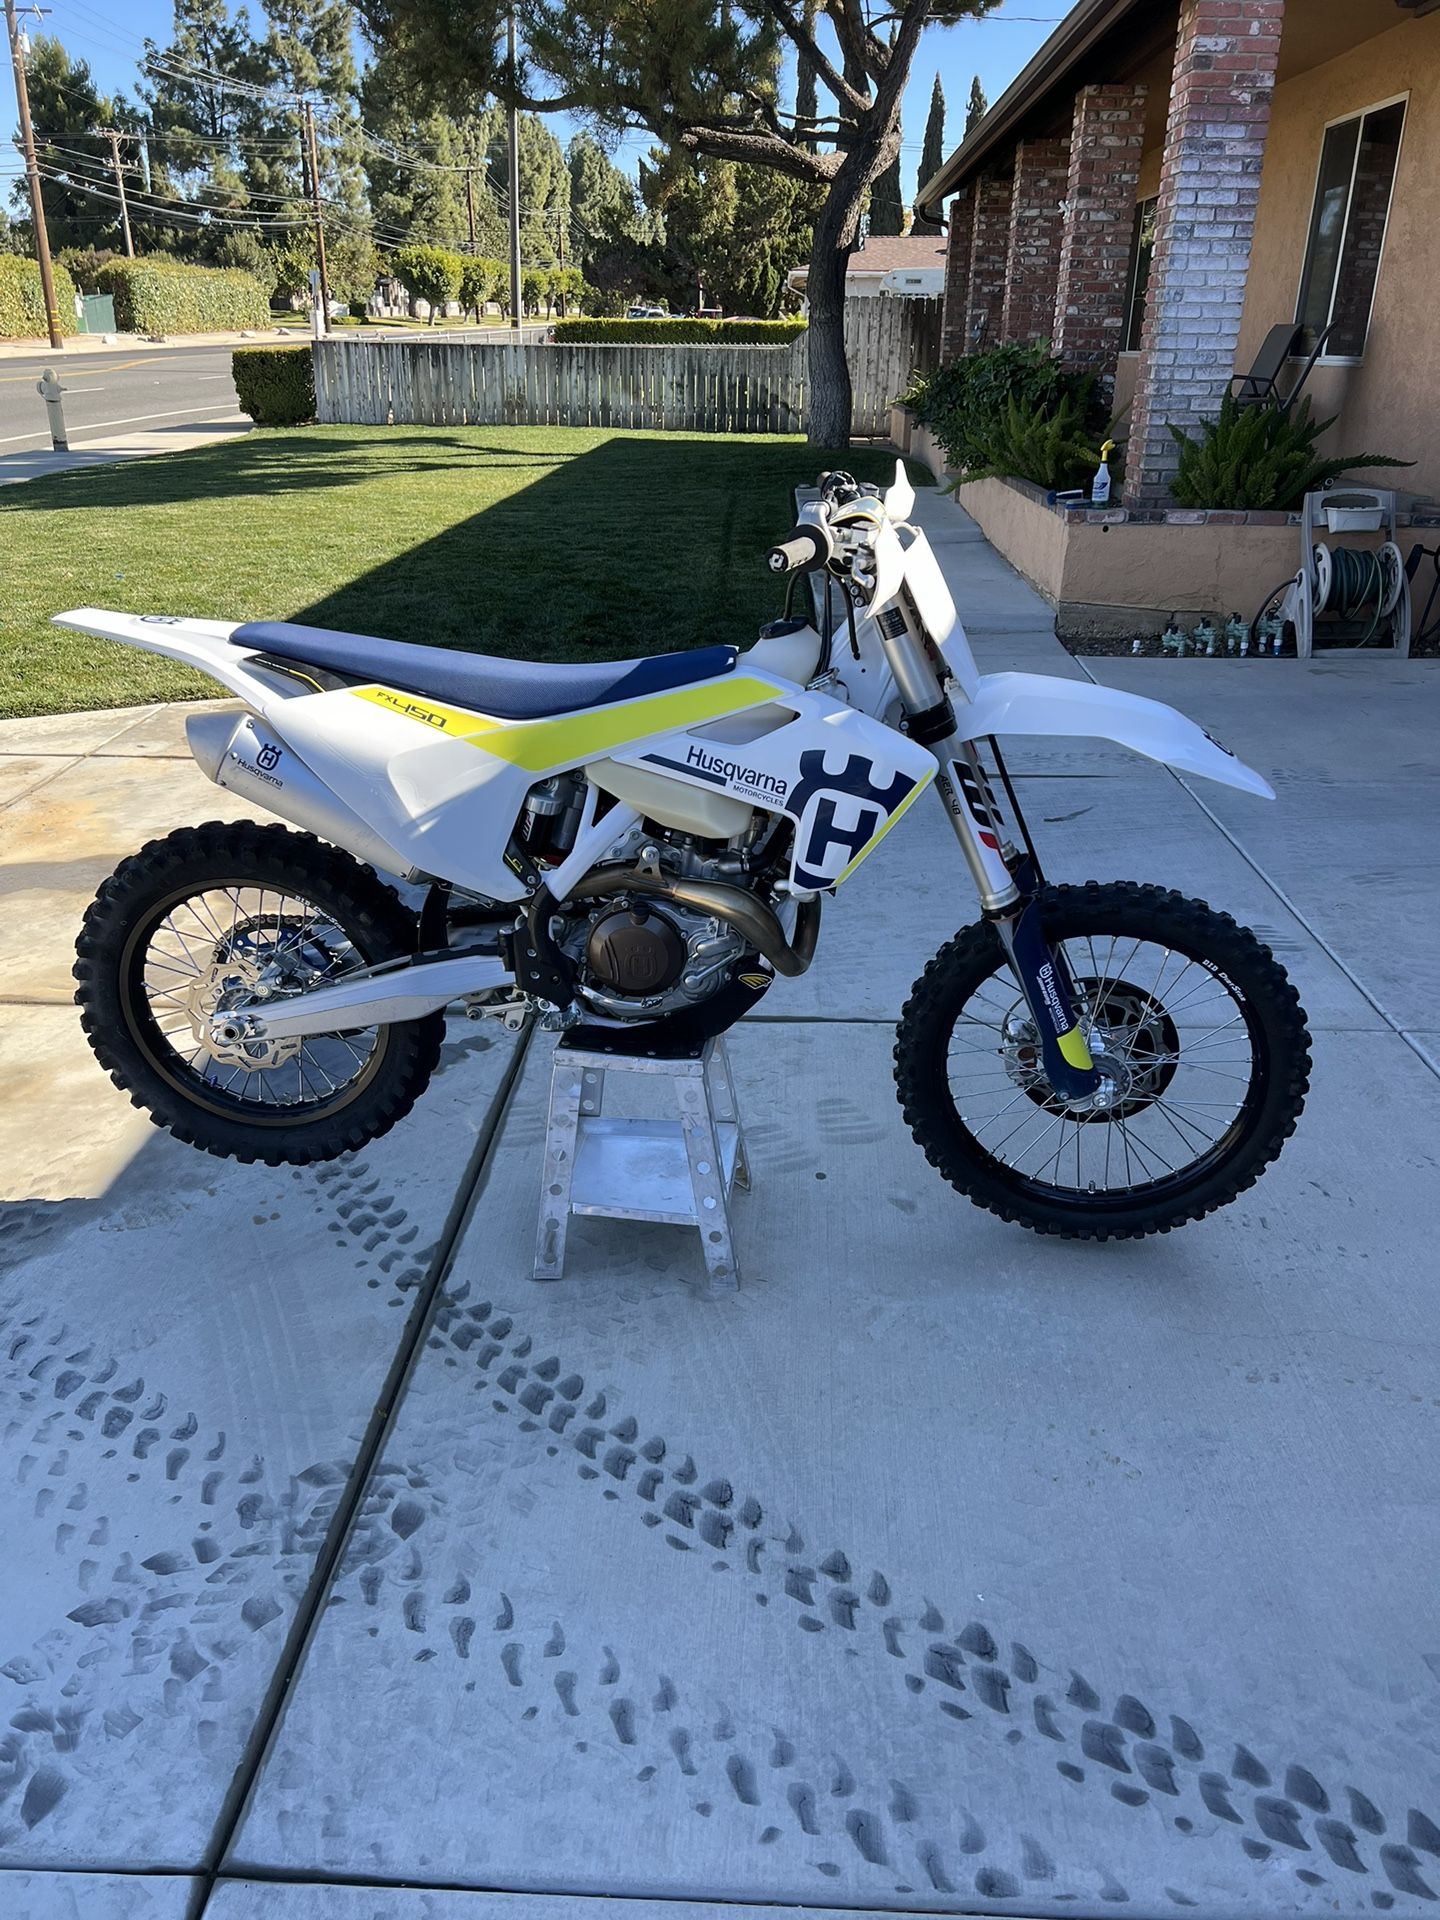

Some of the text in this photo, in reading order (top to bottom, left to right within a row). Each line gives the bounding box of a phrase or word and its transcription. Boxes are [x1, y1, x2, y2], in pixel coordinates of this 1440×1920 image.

[237, 758, 284, 787] Husqvarna
[686, 745, 788, 796] Husqvarna
[732, 784, 785, 807] MOTORCYCLES
[1044, 976, 1069, 1032] Husqvarna
